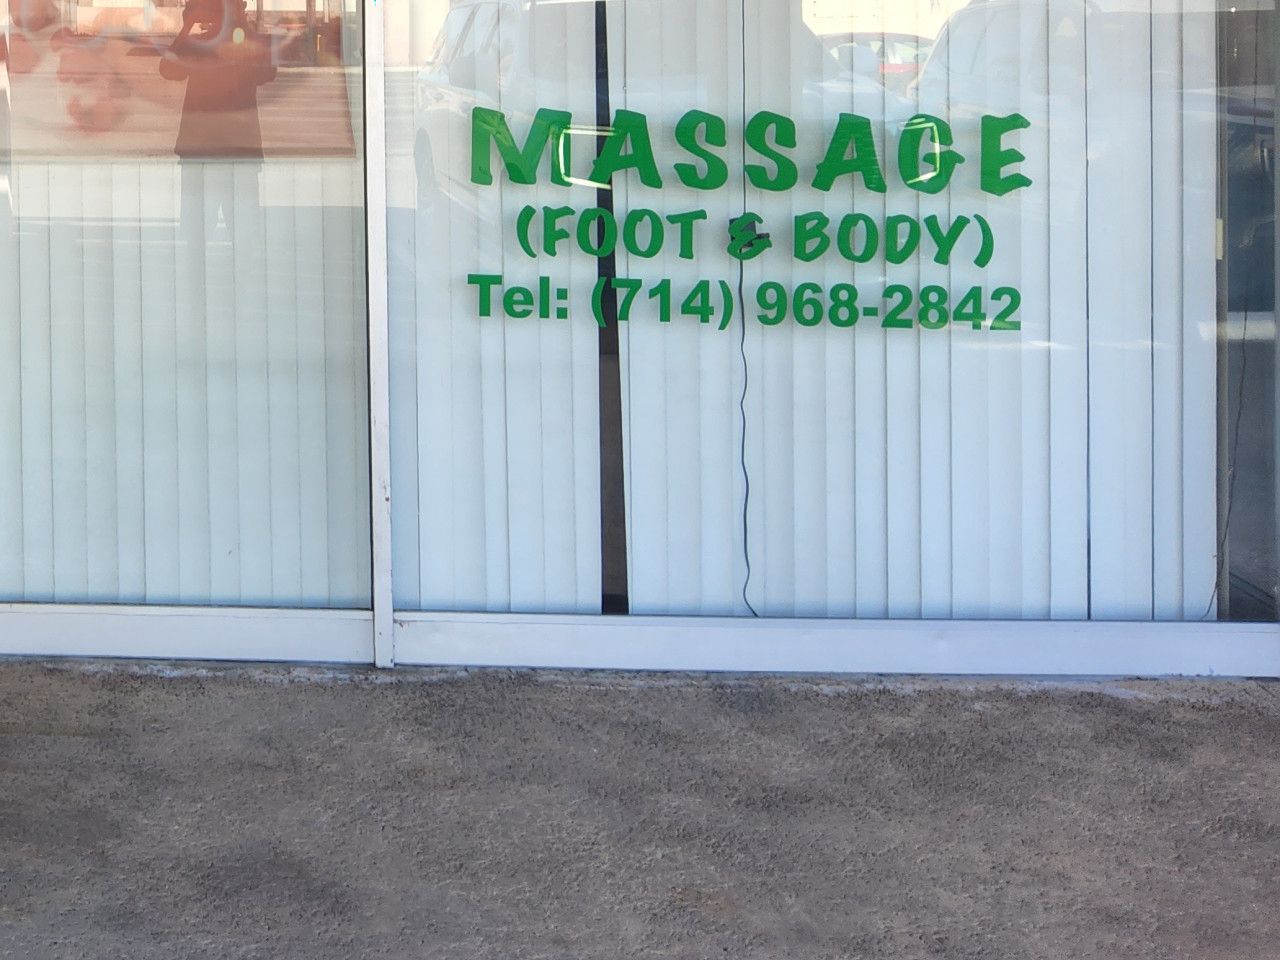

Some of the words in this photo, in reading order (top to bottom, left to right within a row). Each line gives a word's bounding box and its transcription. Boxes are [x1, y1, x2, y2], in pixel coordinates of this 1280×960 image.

[470, 106, 1033, 196] MASSAGE
[517, 205, 707, 260] (FOOT
[726, 213, 772, 262] &
[794, 211, 994, 268] BODY)
[467, 273, 569, 320] Tel:
[591, 276, 734, 330] (714)
[756, 280, 1022, 331] 968-2842
